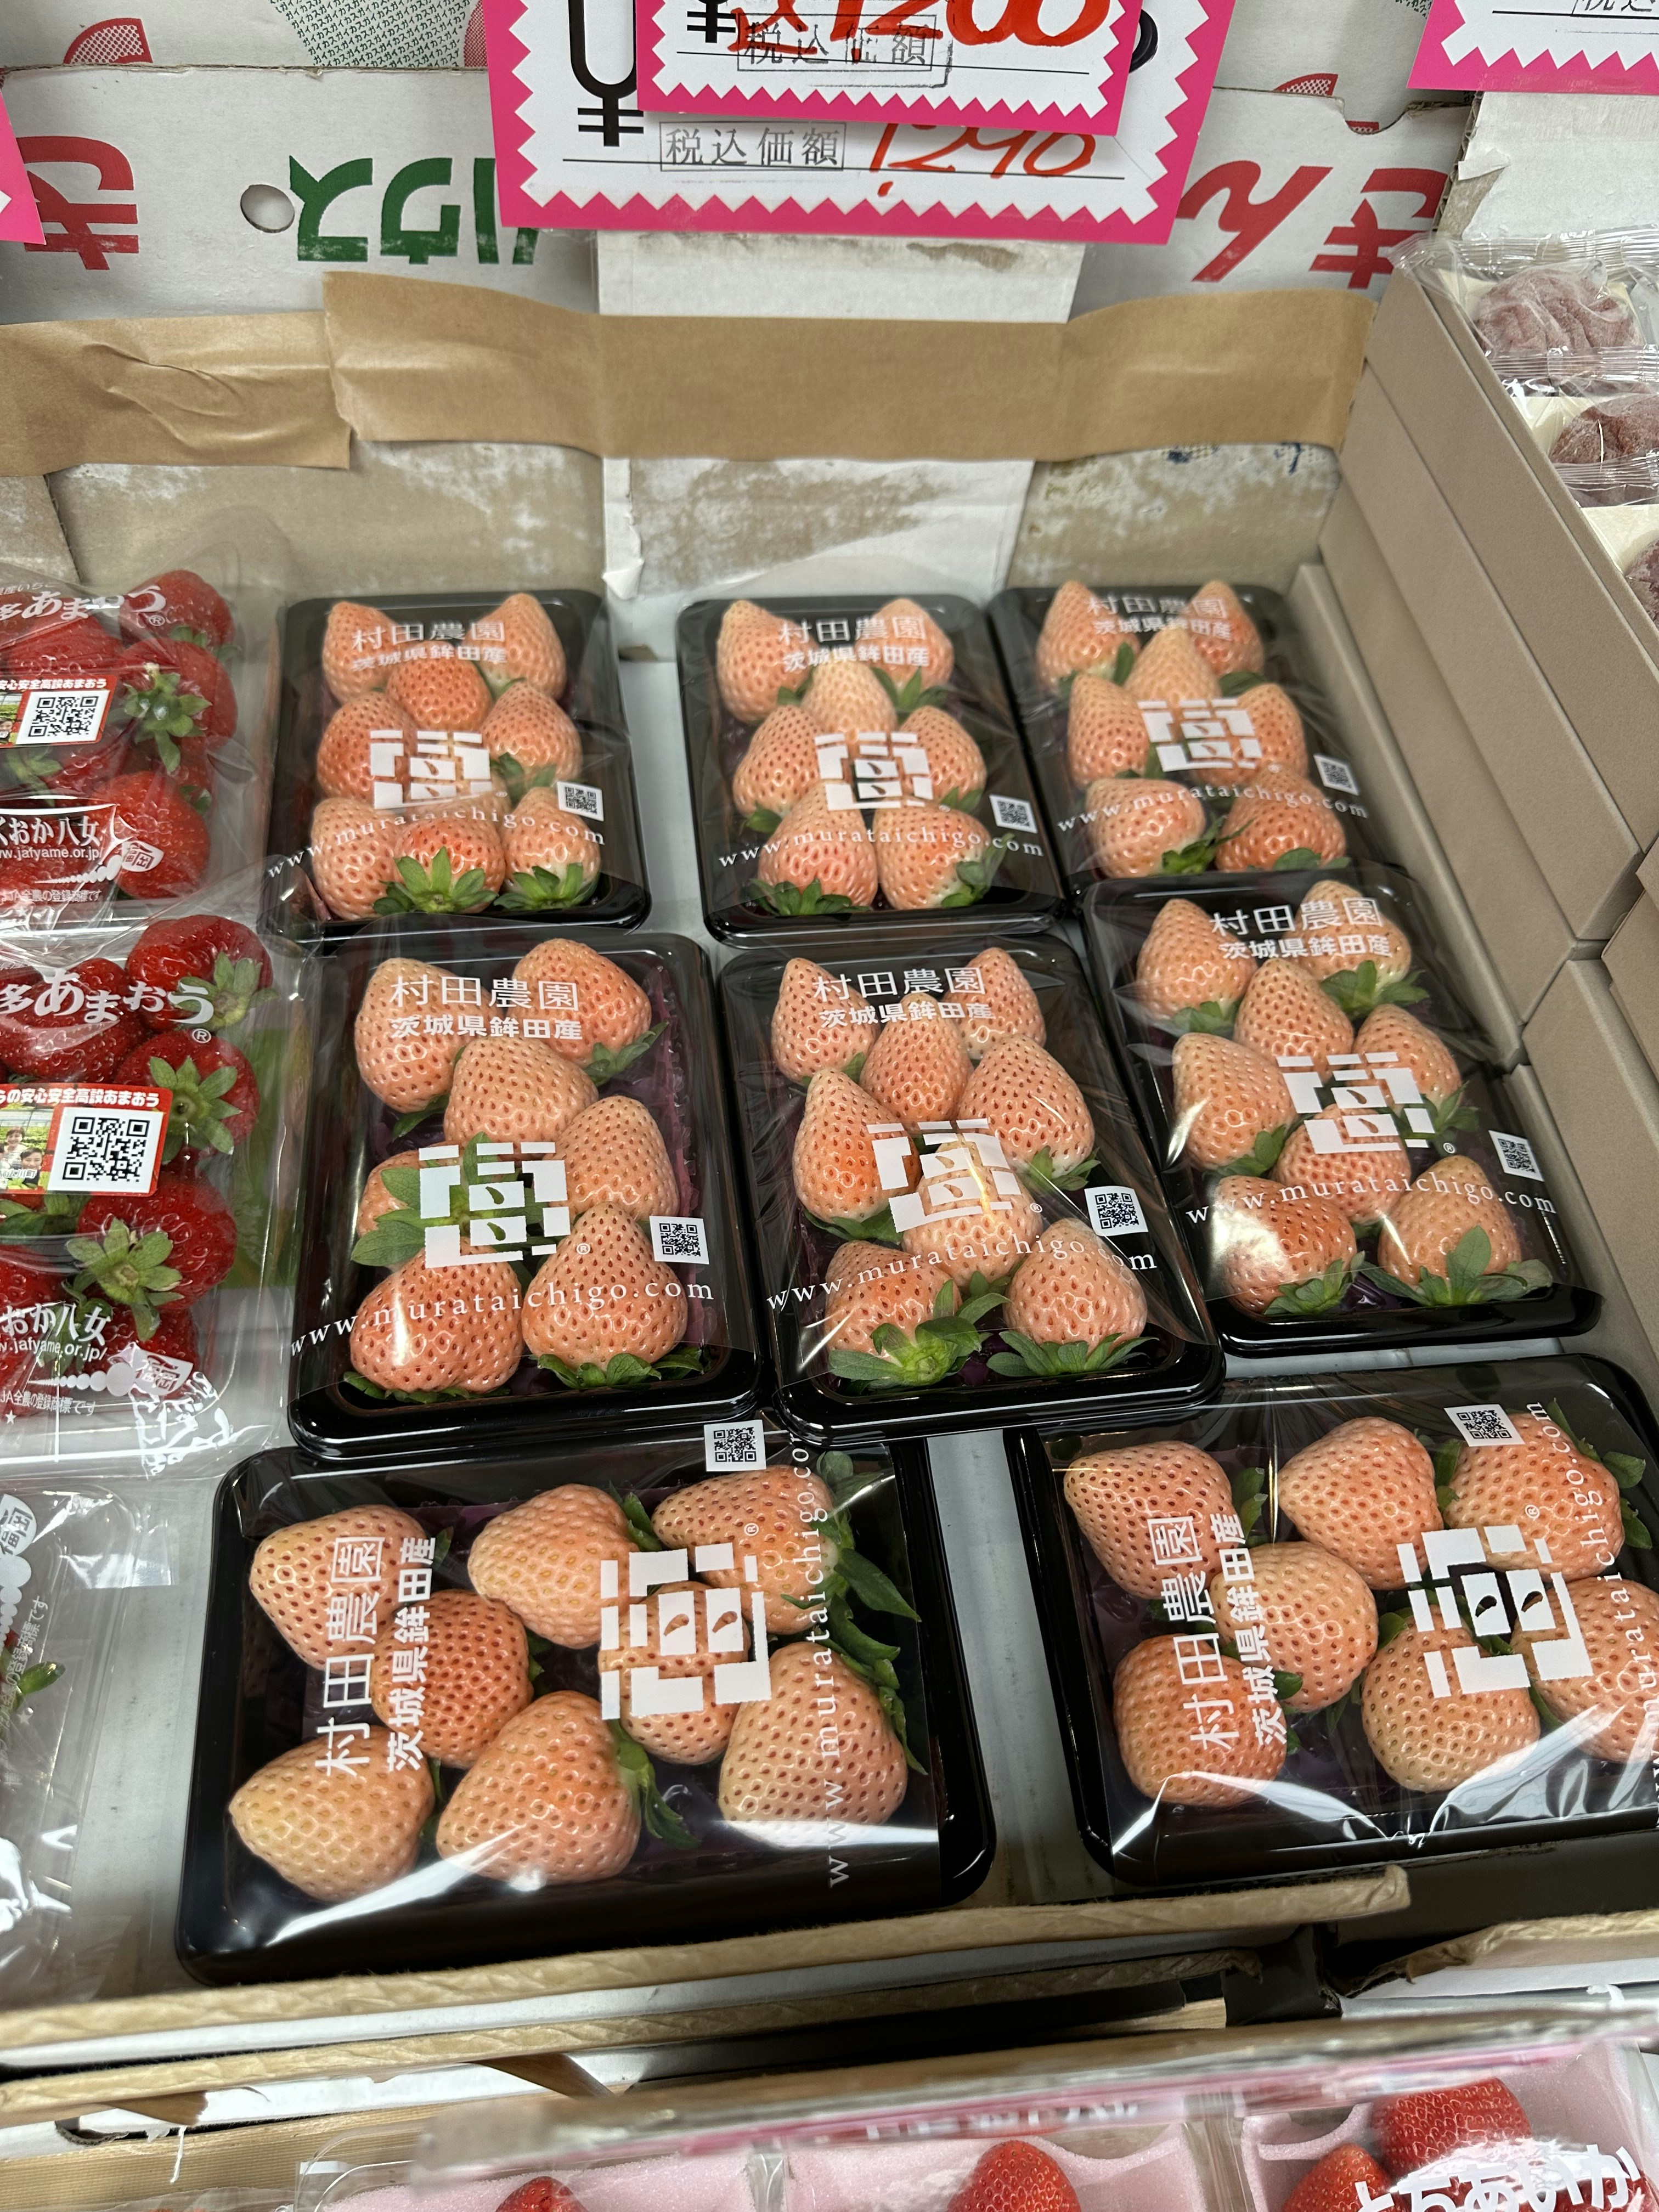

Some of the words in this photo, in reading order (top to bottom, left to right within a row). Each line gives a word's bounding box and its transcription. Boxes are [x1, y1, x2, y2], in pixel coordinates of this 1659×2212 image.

[665, 127, 839, 166] 税込価額
[353, 622, 505, 652] 村田農園
[778, 616, 927, 646] 村田農園
[351, 645, 508, 673] 茨城県鉾田産
[1057, 783, 1368, 833] www.murataichigo.com
[267, 806, 606, 879] www.murataichigo.com
[719, 826, 1044, 868] www.murataichigo.com
[1210, 897, 1384, 937] 村田農園
[1218, 934, 1393, 960] 茨城県鉾田産
[389, 974, 580, 1012] 村田農園
[812, 967, 986, 1003] 村田農園
[389, 1014, 584, 1041] 茨城県鉾田産
[819, 1003, 996, 1029] 茨城県鉾田産
[1185, 1170, 1557, 1226] www.murataichigo.com
[766, 1233, 1158, 1312] www.murataichigo.com
[289, 1281, 715, 1358] www.murataichigo.com
[1147, 1515, 1240, 1751] 村田農園
[1209, 1513, 1288, 1747] 茨城県鉾田産
[315, 1535, 386, 1777] 村田農園
[387, 1536, 437, 1774] 茨城県鉾田産
[790, 1433, 850, 1889] www.murataichigo.co
